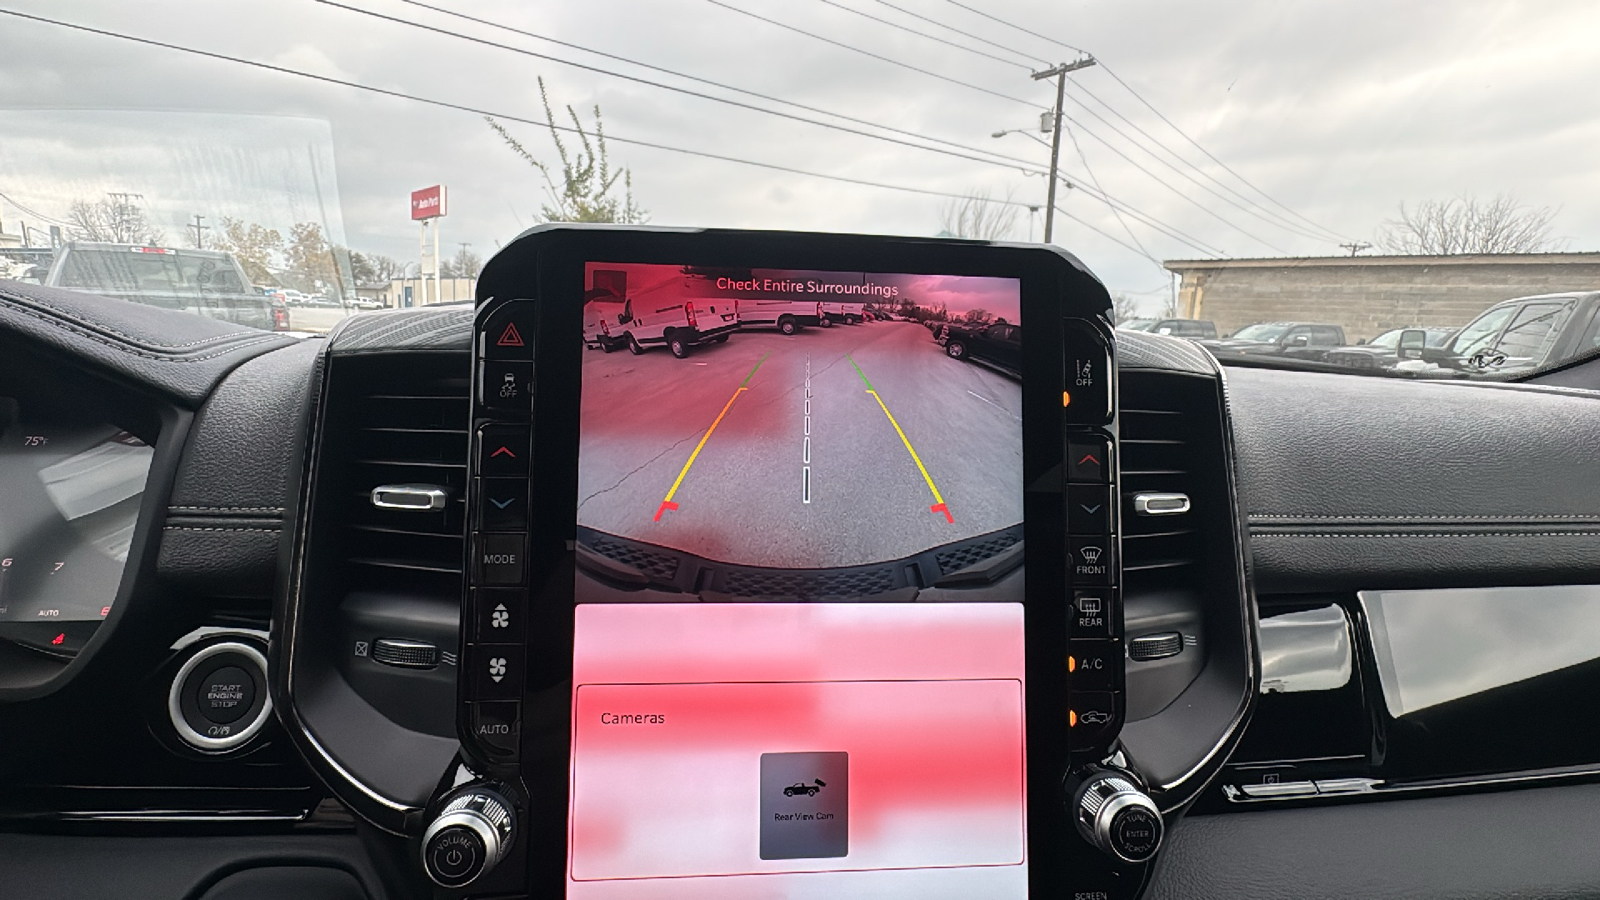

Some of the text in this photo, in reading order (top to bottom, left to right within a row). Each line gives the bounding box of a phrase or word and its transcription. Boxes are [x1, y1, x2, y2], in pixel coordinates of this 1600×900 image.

[716, 277, 899, 298] Check Entire Surroundings
[1075, 378, 1093, 387] OFF
[499, 389, 518, 398] OFF
[1, 558, 13, 567] 6
[484, 554, 516, 564] MODE
[54, 561, 65, 571] 7
[1076, 565, 1106, 574] FRONT
[38, 609, 59, 617] AUTO
[1079, 617, 1103, 627] REAR
[1081, 658, 1103, 670] A/C
[211, 684, 242, 692] START
[207, 692, 243, 700] ENGINE
[601, 712, 665, 725] Cameras
[480, 724, 509, 734] AUTO
[774, 811, 834, 821] Rear View Cam
[1126, 814, 1147, 823] TUNE
[1126, 830, 1149, 838] ENTER
[437, 836, 472, 850] VOLUME
[1124, 842, 1151, 853] SCROLL
[1074, 891, 1108, 900] SCREEN
